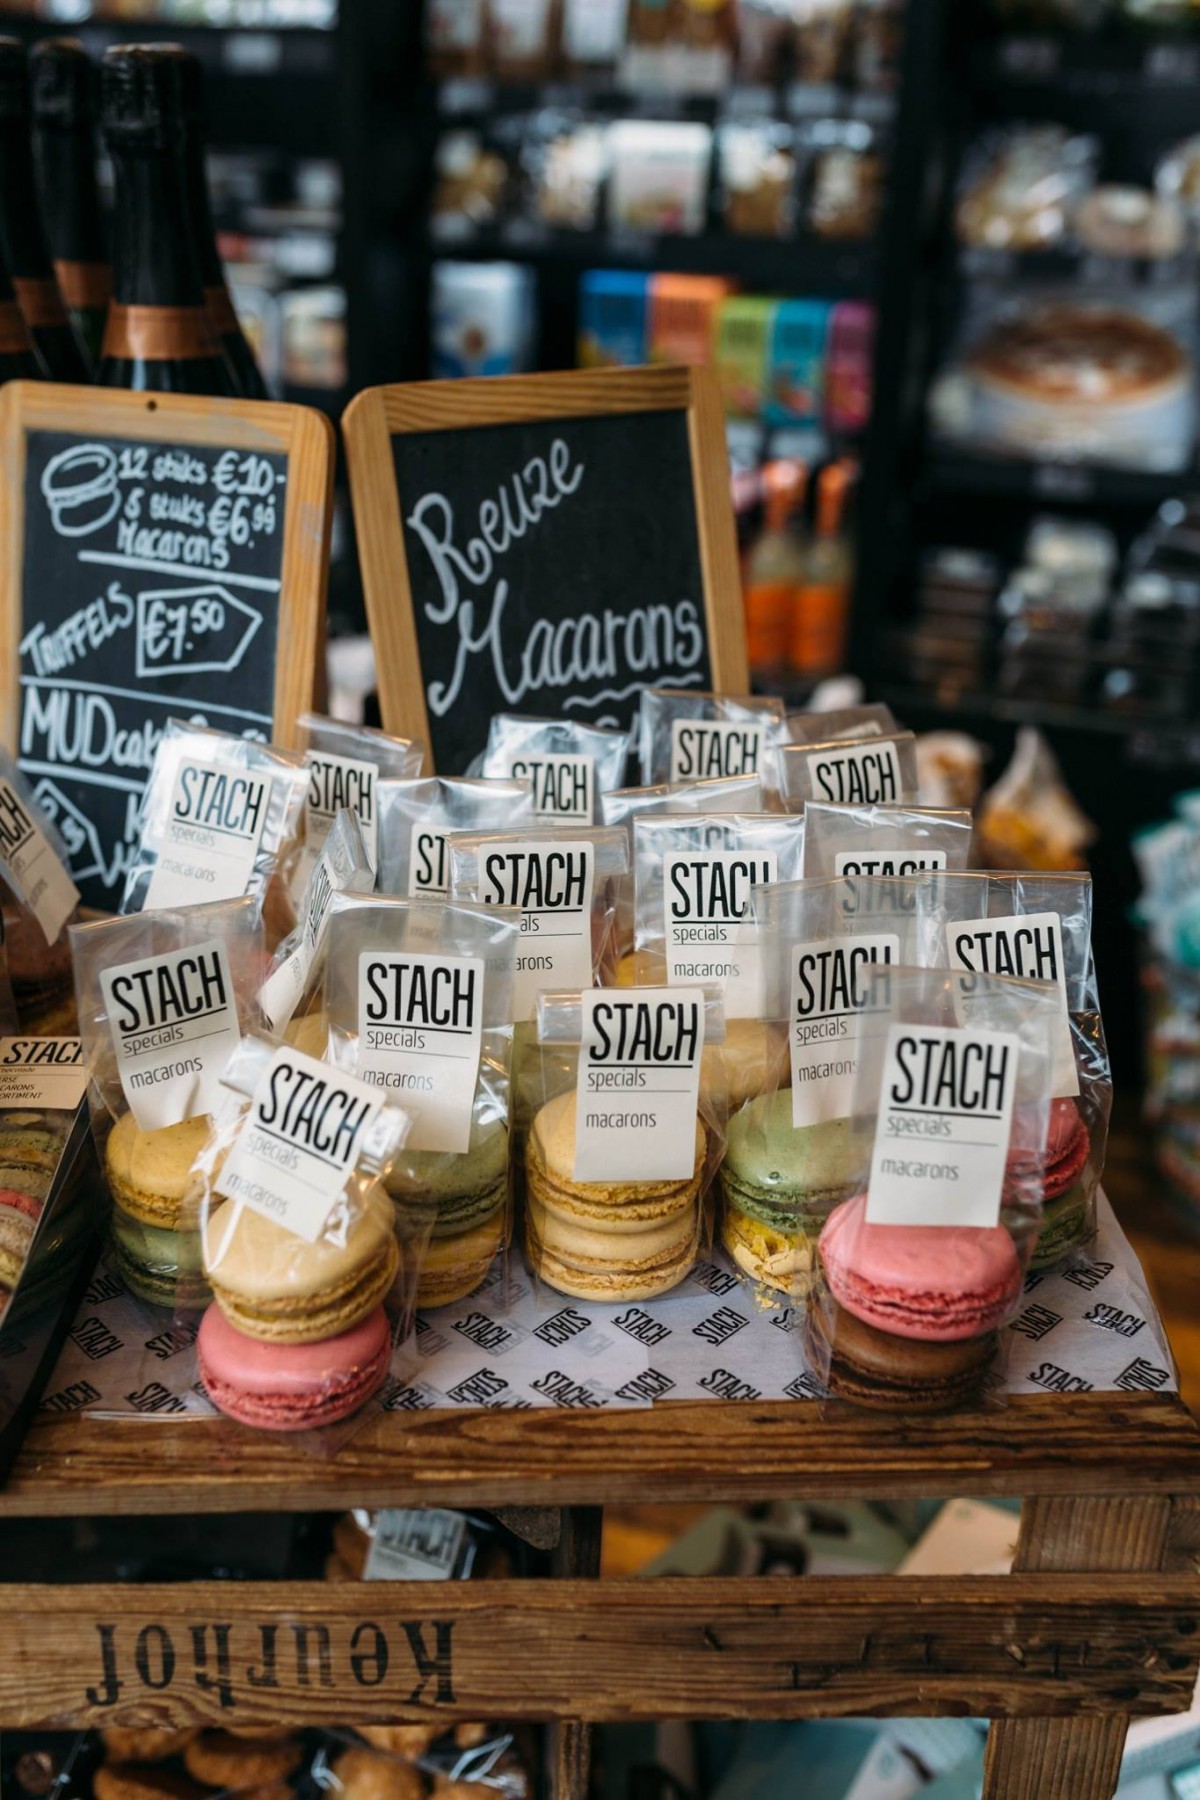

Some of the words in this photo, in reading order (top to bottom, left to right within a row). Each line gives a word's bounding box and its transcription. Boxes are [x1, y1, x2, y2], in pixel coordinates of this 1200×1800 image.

[118, 447, 149, 480] 12
[152, 452, 207, 486] stuks
[150, 492, 205, 528] stuks
[117, 518, 230, 569] Macarons
[407, 439, 584, 624] Reuze
[427, 579, 703, 716] Macarons
[22, 685, 165, 770] MUDcak
[678, 729, 758, 777] STACH
[309, 761, 371, 820] STACH
[816, 751, 896, 804] STACH
[175, 766, 265, 834] STACH
[485, 852, 586, 908] STACH
[673, 925, 728, 944] specials
[674, 963, 740, 977] macarons
[956, 926, 1058, 991] STACH
[111, 951, 226, 1034] STACH
[366, 962, 475, 1027] STACH
[798, 946, 890, 1015] STACH
[123, 1025, 184, 1055] specials
[366, 1029, 425, 1049] specials
[589, 1003, 698, 1062] STACH
[796, 1017, 848, 1045] specials
[130, 1057, 203, 1089] macarons
[363, 1069, 434, 1091] macarons
[587, 1068, 647, 1092] specials
[891, 1037, 1009, 1111] STACH
[259, 1064, 370, 1163] STACH
[586, 1113, 657, 1128] macarons
[886, 1116, 952, 1138] specials
[881, 1157, 959, 1181] macarons
[226, 1172, 289, 1217] macarons
[692, 1262, 739, 1296] TACH
[71, 1317, 124, 1360] STACH
[454, 1312, 513, 1349] STACH
[534, 1307, 592, 1348] STACH
[615, 1308, 673, 1347] STACH
[692, 1306, 748, 1345] STACH
[1008, 1303, 1061, 1340] STACH
[1085, 1303, 1146, 1337] STACH
[86, 1620, 457, 1707] Keurhof
